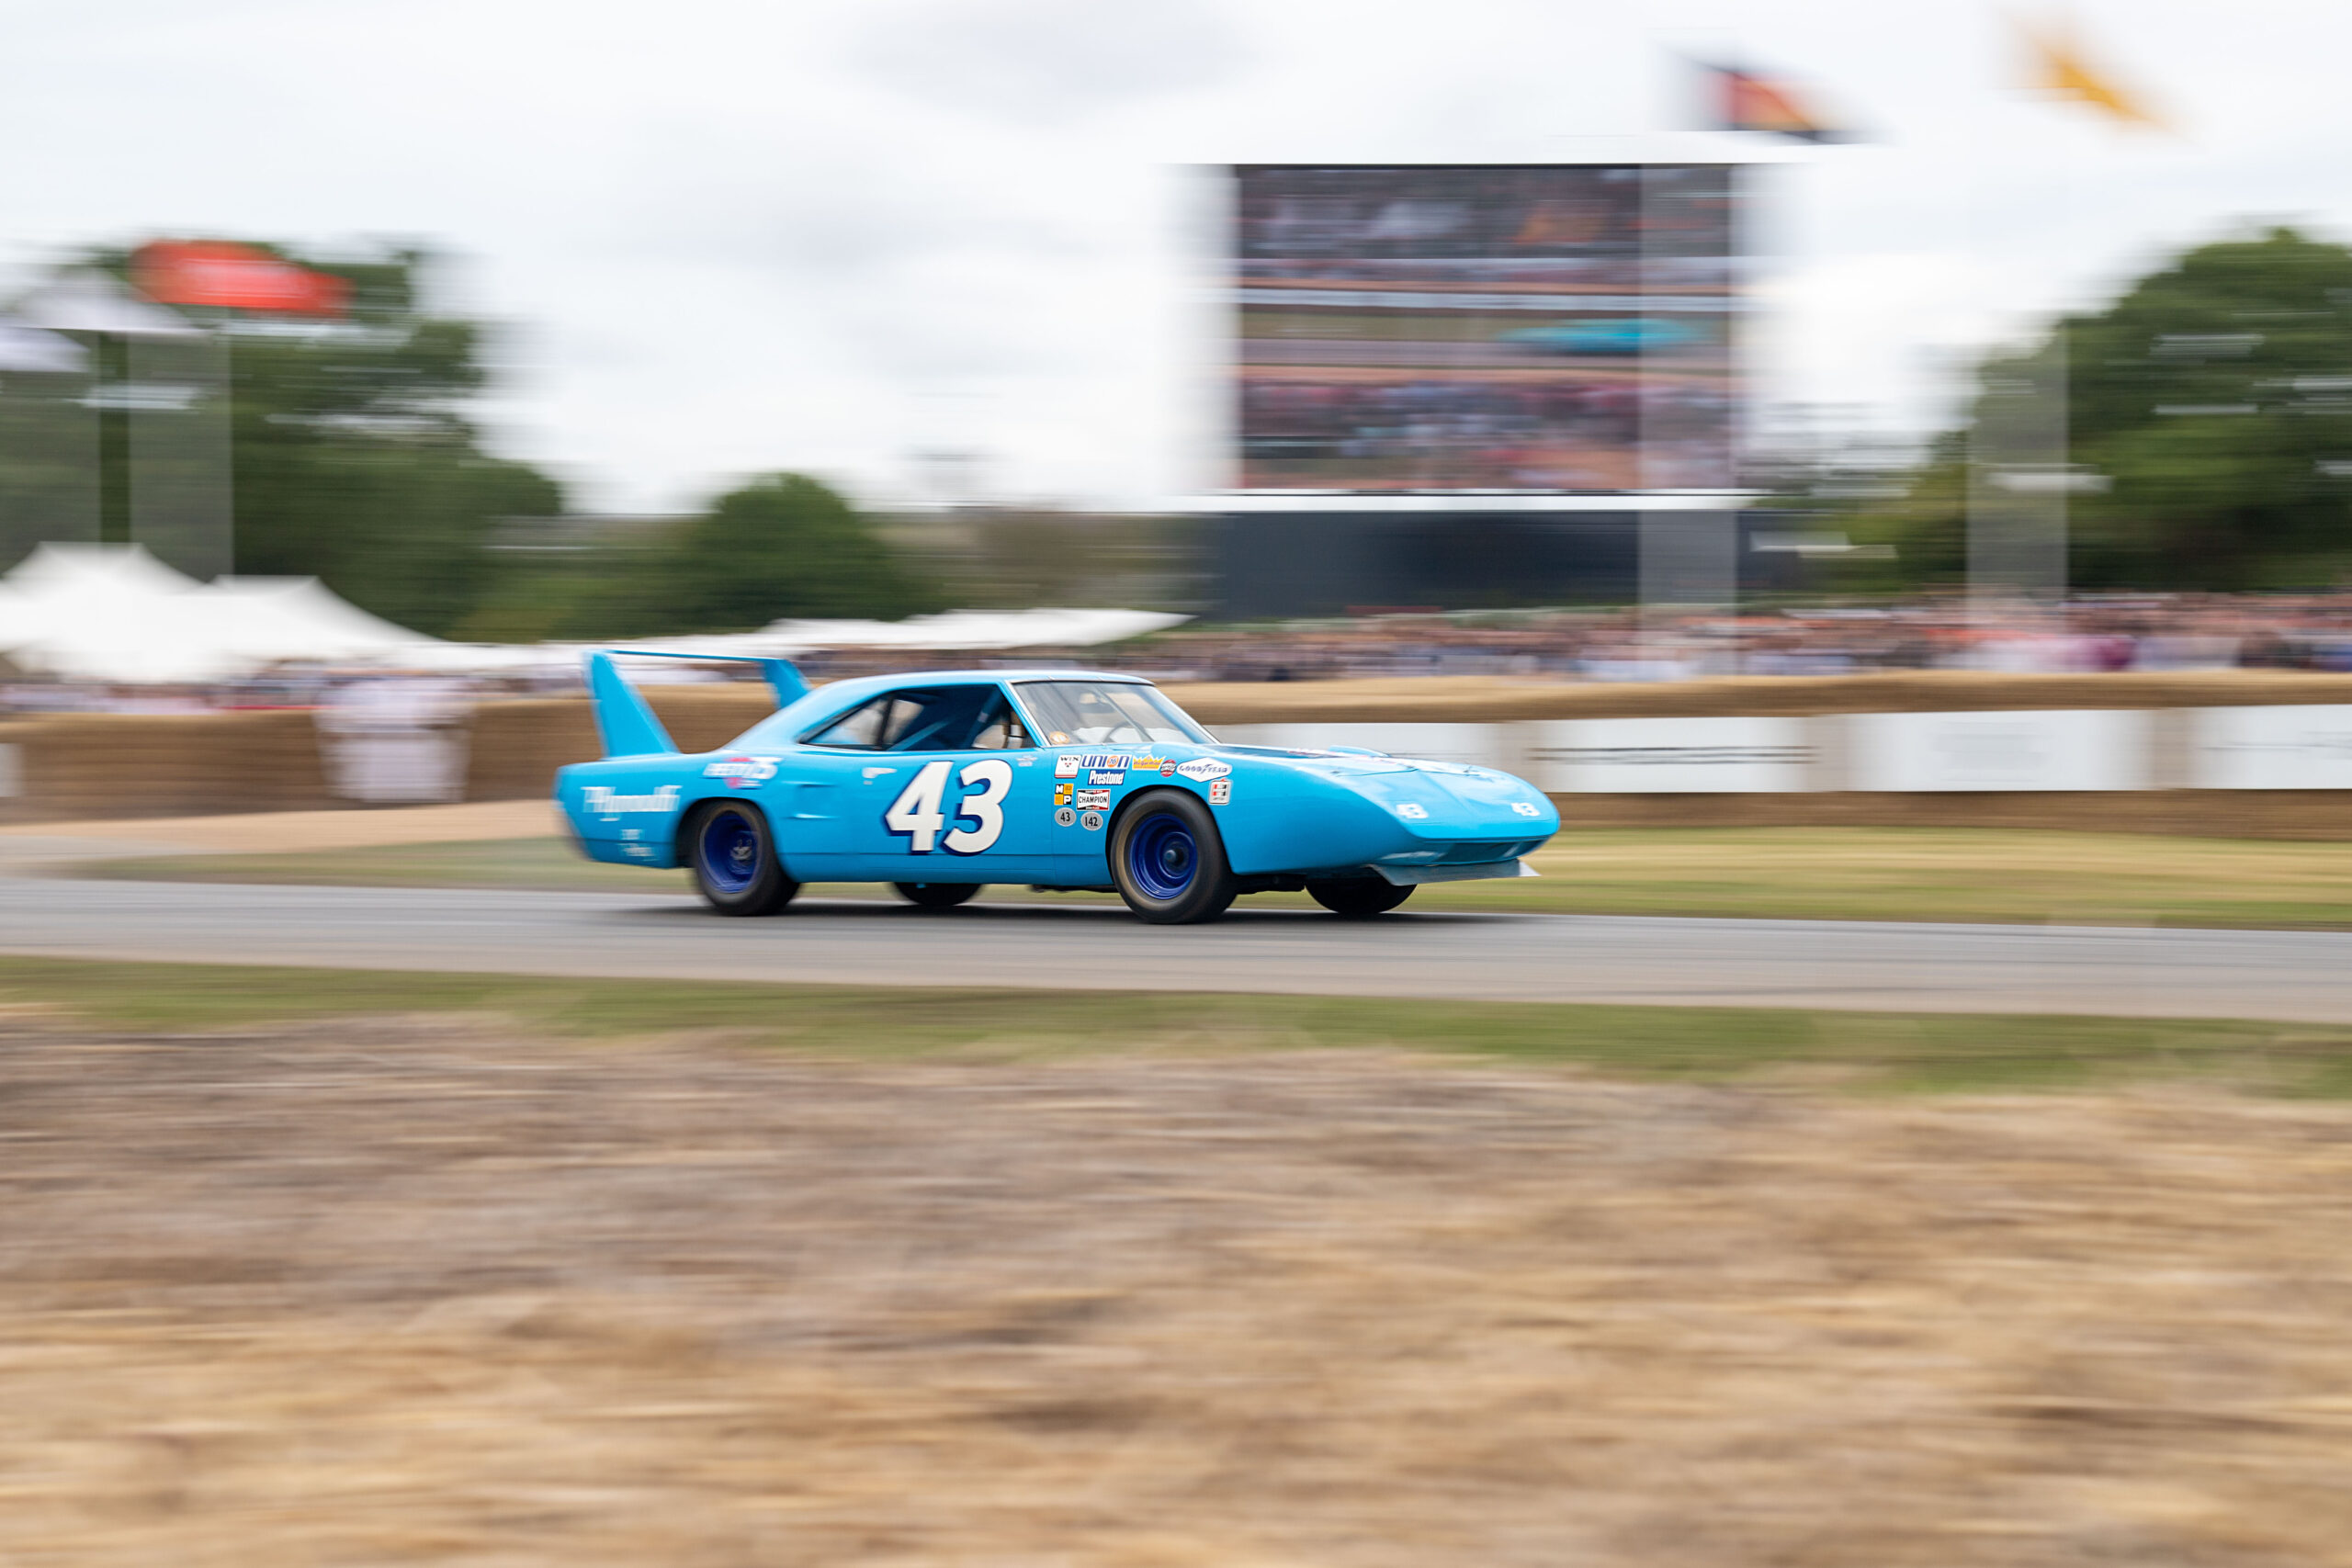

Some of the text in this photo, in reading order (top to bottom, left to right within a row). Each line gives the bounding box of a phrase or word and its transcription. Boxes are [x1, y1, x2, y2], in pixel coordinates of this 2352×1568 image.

[1088, 770, 1125, 785] Prestone
[1064, 795, 1072, 805] P
[1078, 795, 1108, 804] CHAMPION
[883, 759, 1013, 855] 43
[1060, 811, 1071, 822] 43
[1084, 816, 1099, 827] 142
